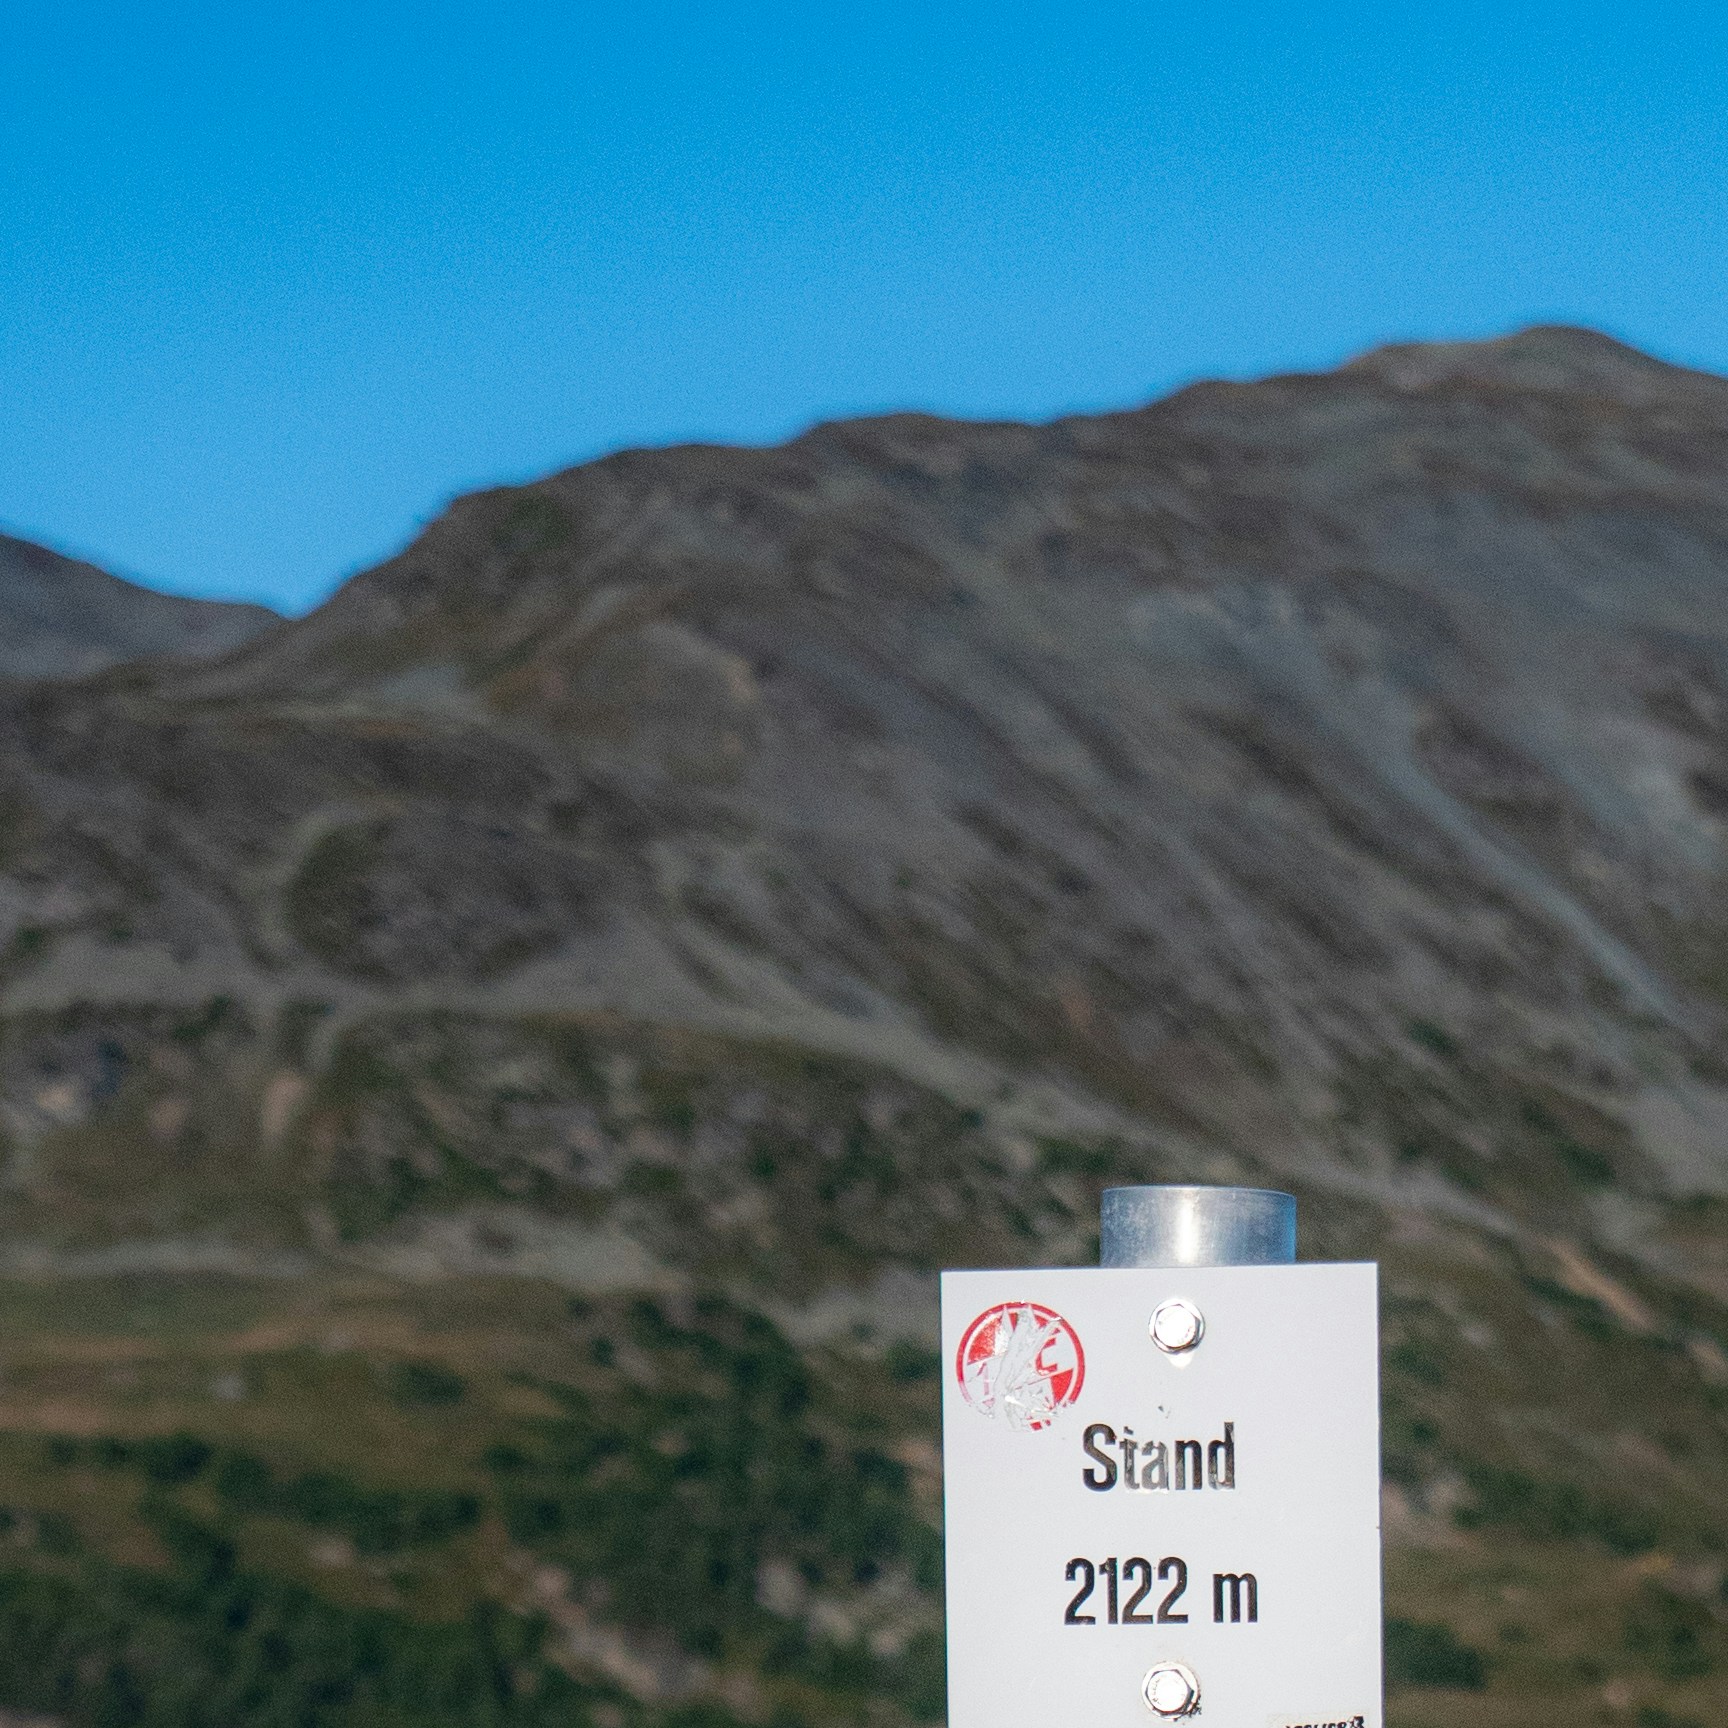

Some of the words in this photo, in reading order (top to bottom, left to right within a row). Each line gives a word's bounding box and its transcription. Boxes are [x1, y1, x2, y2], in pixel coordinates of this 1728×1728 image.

[1081, 1421, 1236, 1492] Stand
[1064, 1556, 1189, 1626] 2122
[1212, 1572, 1258, 1624] m
